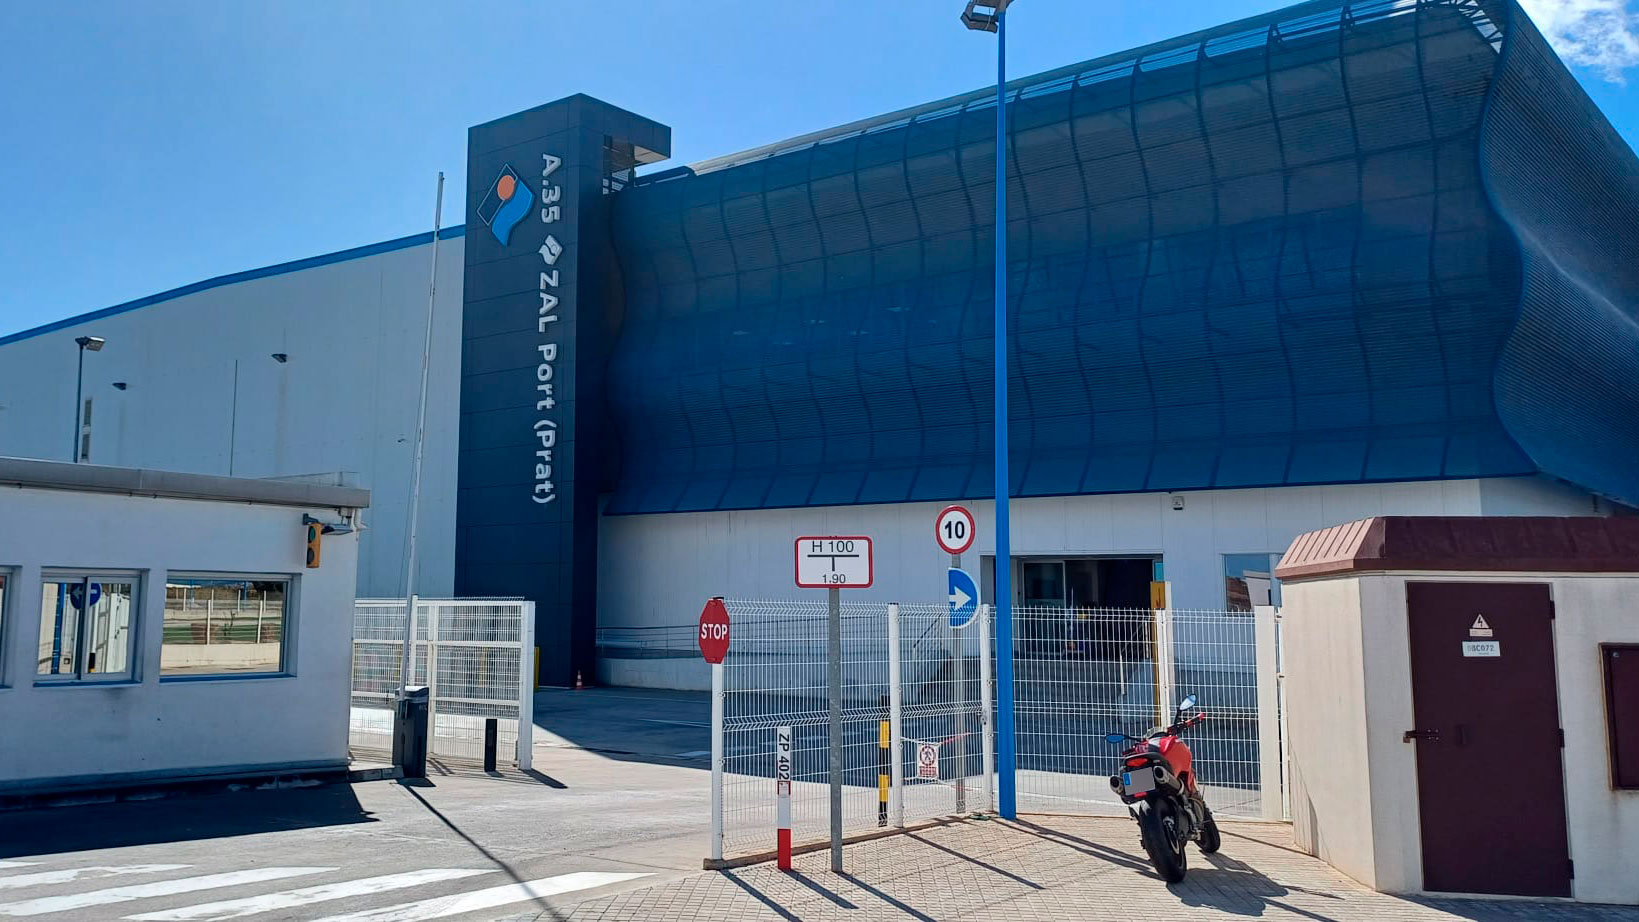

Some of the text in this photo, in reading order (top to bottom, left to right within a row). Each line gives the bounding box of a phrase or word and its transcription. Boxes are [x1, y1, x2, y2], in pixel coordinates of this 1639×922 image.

[532, 153, 562, 504] A.35 ZAL Port (Prat)
[944, 521, 965, 538] 10
[812, 540, 854, 553] H 100
[822, 574, 846, 584] 1.90
[701, 623, 728, 640] STOP
[779, 734, 790, 752] ZP
[779, 756, 790, 780] 402
